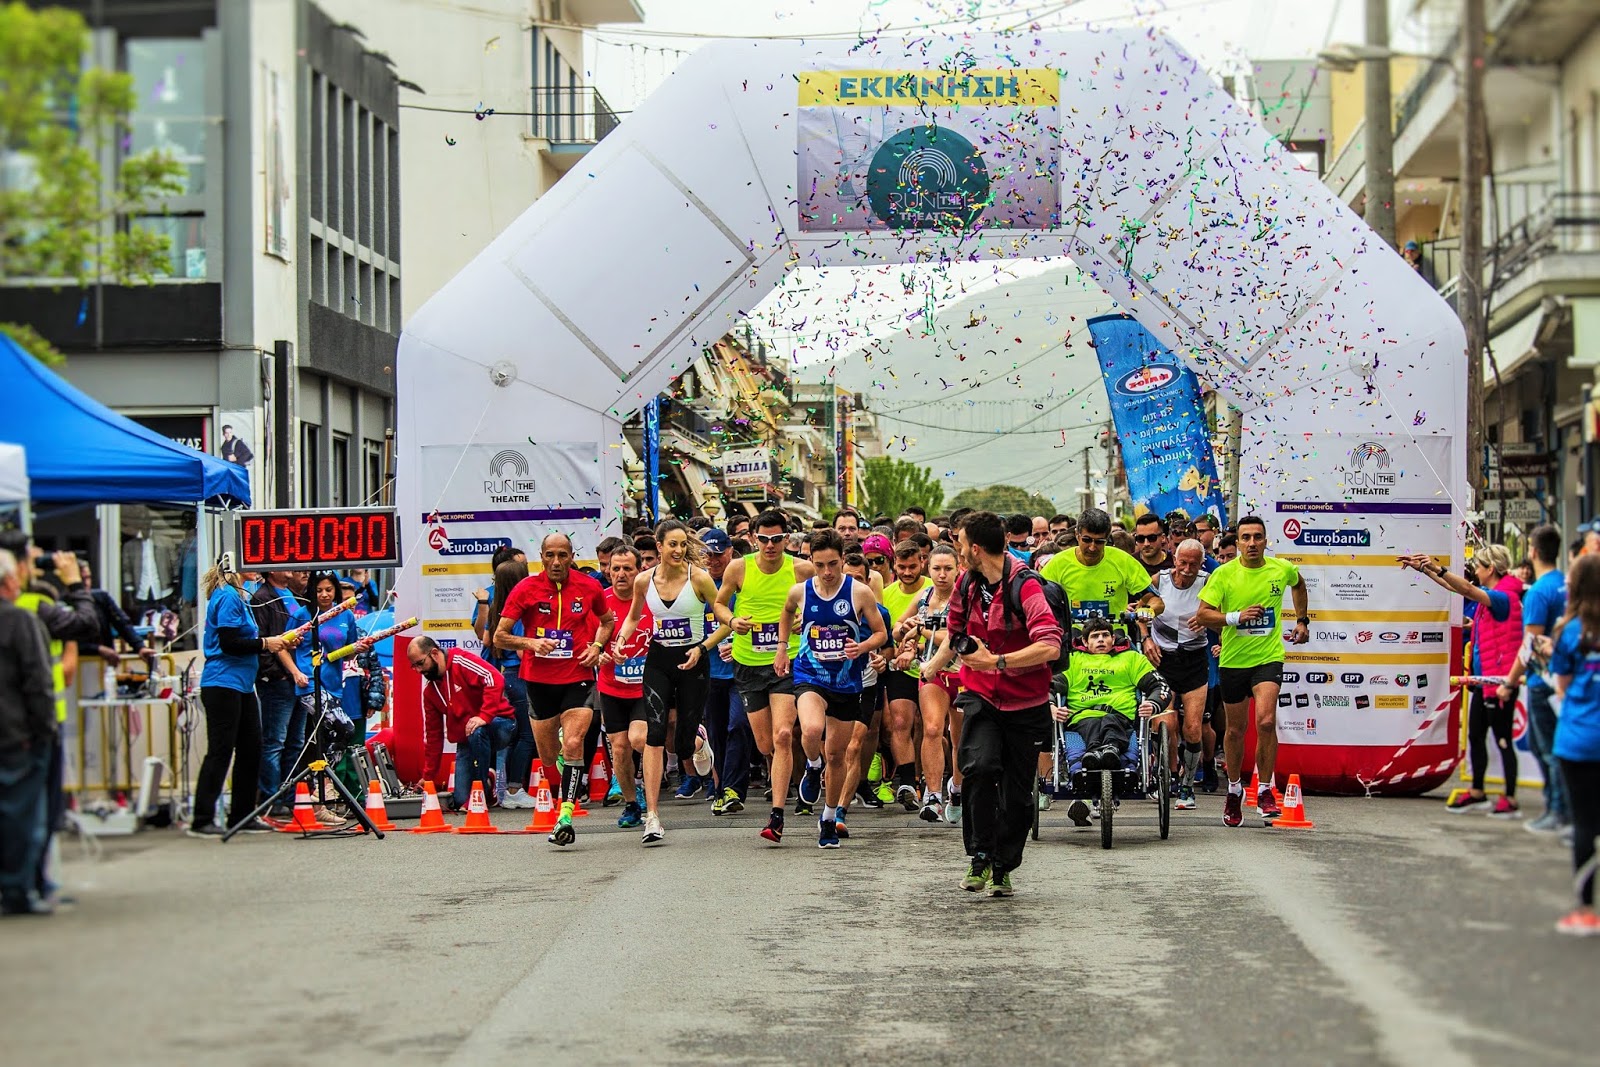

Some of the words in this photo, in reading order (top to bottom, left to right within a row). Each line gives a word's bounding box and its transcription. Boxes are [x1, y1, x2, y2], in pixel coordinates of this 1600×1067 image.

[840, 76, 1018, 98] ΕΚΚΙΝΗΣΗ
[889, 193, 936, 209] RUN
[899, 211, 957, 221] THEATR
[176, 438, 203, 450] ΚΑΣ
[726, 461, 768, 474] ΑΣΠΙΔΑ
[1344, 472, 1376, 486] RUN
[1378, 475, 1394, 483] THE
[484, 480, 515, 493] RUN
[518, 482, 534, 490] THE
[1350, 487, 1390, 496] THEATRE
[490, 495, 530, 503] THEATRE
[245, 515, 387, 562] 00:00:00
[1304, 531, 1365, 545] Eurobank
[659, 628, 685, 638] 5005
[758, 632, 778, 643] 504
[815, 639, 843, 649] 5085
[621, 665, 645, 675] 1069
